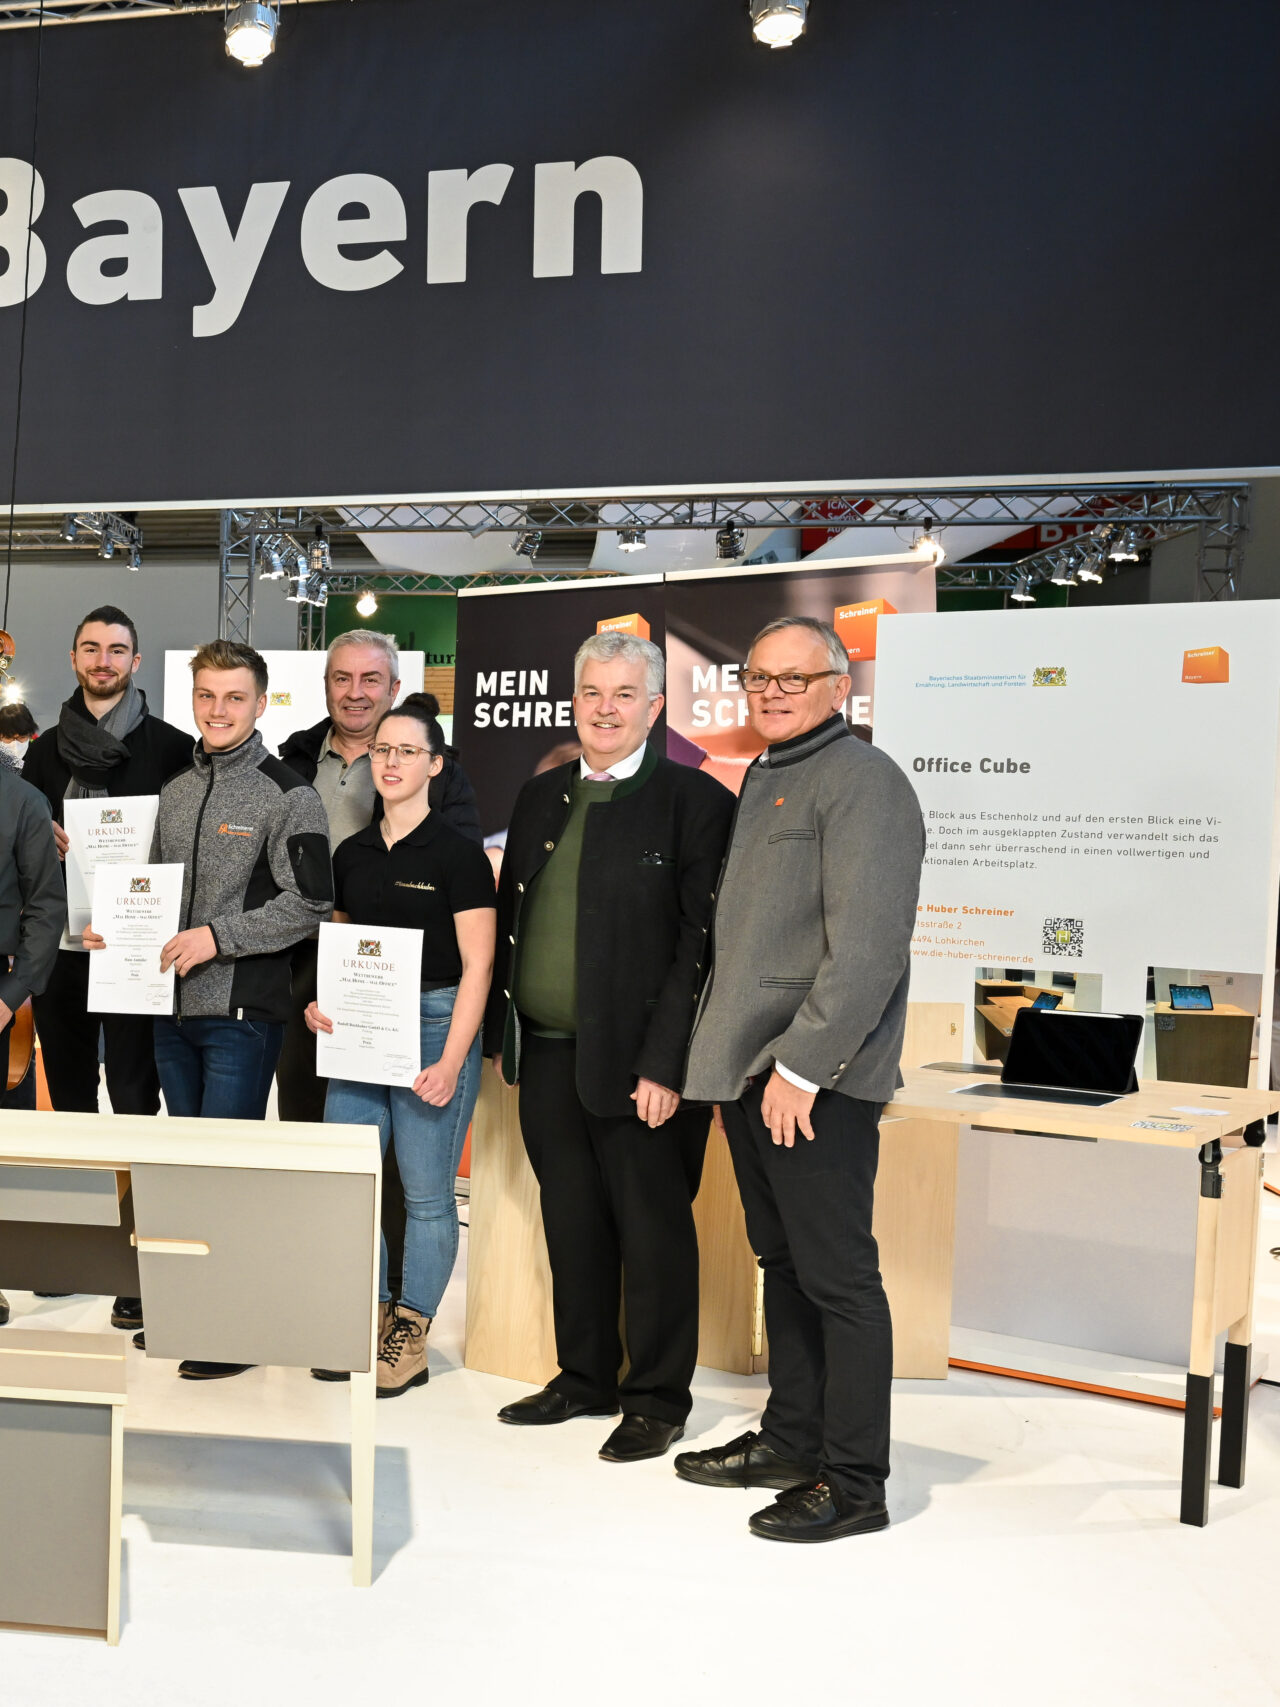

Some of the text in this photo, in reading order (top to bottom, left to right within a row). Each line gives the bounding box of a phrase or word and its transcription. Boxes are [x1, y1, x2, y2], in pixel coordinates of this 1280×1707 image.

[839, 606, 878, 620] Schreiner
[600, 620, 633, 632] Schreiner
[425, 651, 456, 665] tur
[475, 669, 549, 697] MEIN
[691, 663, 749, 693] ME
[473, 700, 578, 729] SCHRE
[912, 756, 1031, 774] Office Cube
[929, 810, 956, 820] Block
[959, 812, 977, 820] aus
[980, 811, 1038, 822] Eschenholz
[1042, 813, 1061, 822] und
[1065, 813, 1082, 823] auf
[1085, 814, 1105, 823] den
[1108, 815, 1144, 824] ersten
[1147, 815, 1175, 825] Blick
[1178, 815, 1202, 826] eine
[1205, 816, 1222, 826] Vi-
[87, 826, 137, 836] URKUNDE
[938, 826, 963, 835] Doch
[966, 827, 979, 836] im
[982, 827, 1057, 839] ausgeklappten
[1060, 829, 1103, 839] Zustand
[1107, 831, 1169, 841] verwandelt
[1172, 832, 1195, 842] sich
[1198, 833, 1219, 843] das
[941, 842, 966, 851] dann
[969, 843, 991, 852] sehr
[995, 842, 1067, 854] überraschend
[1070, 845, 1080, 855] in
[1083, 846, 1113, 856] einen
[1116, 847, 1185, 860] vollwertigen
[1189, 850, 1210, 859] und
[972, 858, 1038, 869] Arbeitsplatz.
[116, 897, 162, 906] URKUNDE
[926, 904, 959, 914] Huber
[962, 905, 1015, 917] Schreiner
[956, 921, 963, 930] 2
[935, 936, 985, 947] Lohkirchen
[910, 949, 1034, 964] ww.die-huber-schreiner.de
[343, 958, 396, 971] URKUNDE
